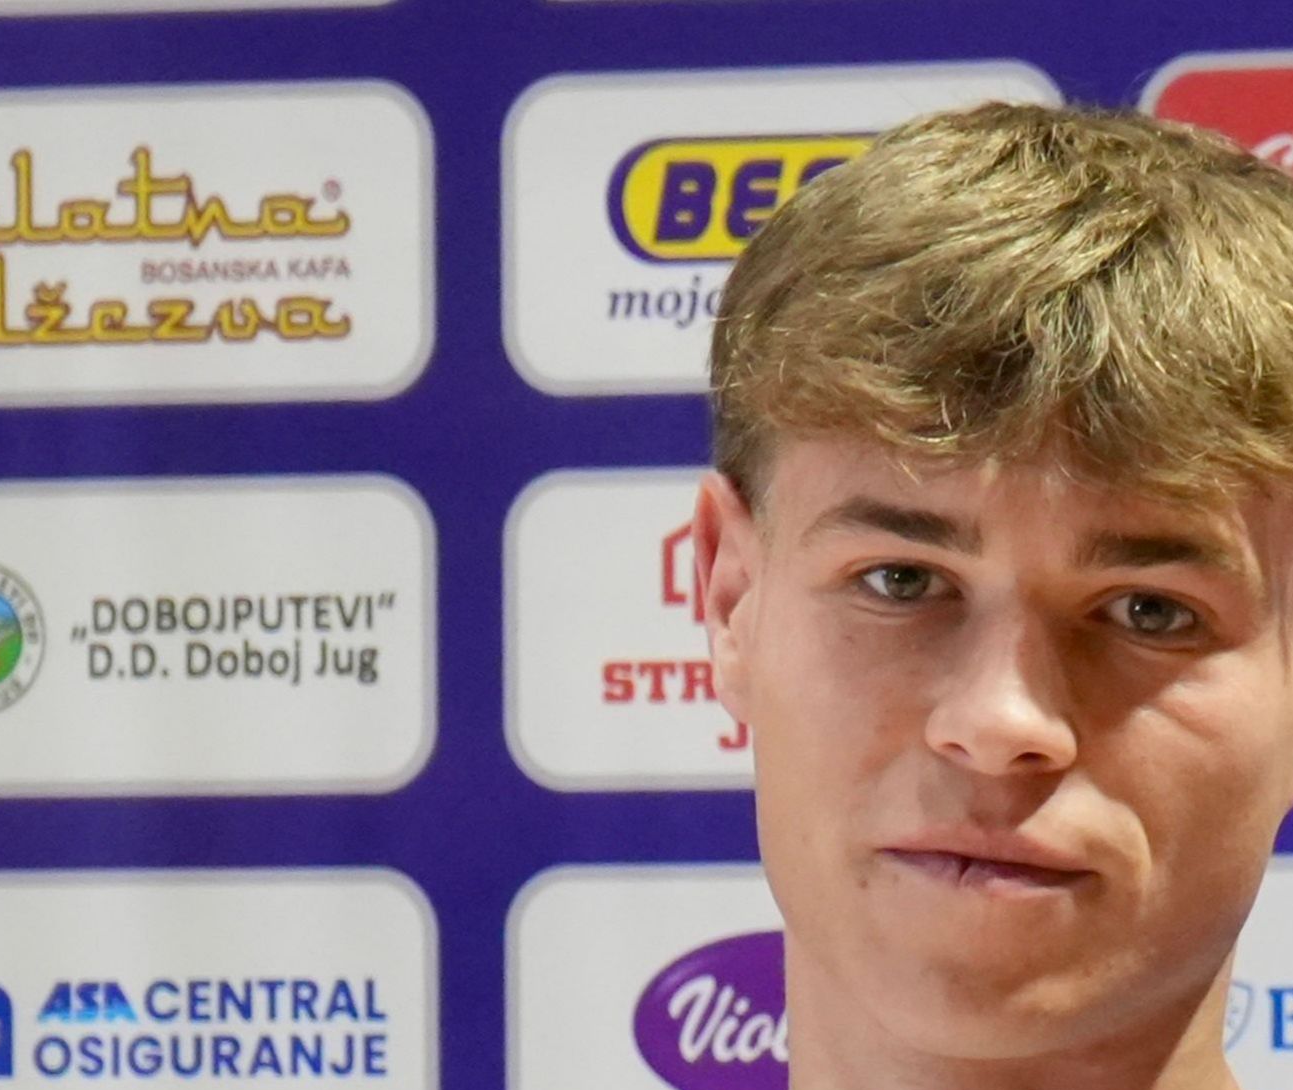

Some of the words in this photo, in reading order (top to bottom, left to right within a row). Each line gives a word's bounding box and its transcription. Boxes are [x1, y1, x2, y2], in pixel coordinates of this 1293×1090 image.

[141, 260, 279, 283] BOSANSKA
[287, 257, 352, 281] KAFA
[88, 644, 169, 679] D.D.
[186, 640, 302, 686] Doboj
[315, 642, 378, 683] Jug
[603, 662, 717, 702] STR
[37, 982, 137, 1023] ASA
[144, 980, 387, 1022] CENTRAL
[33, 1035, 387, 1077] OSIGURANJE
